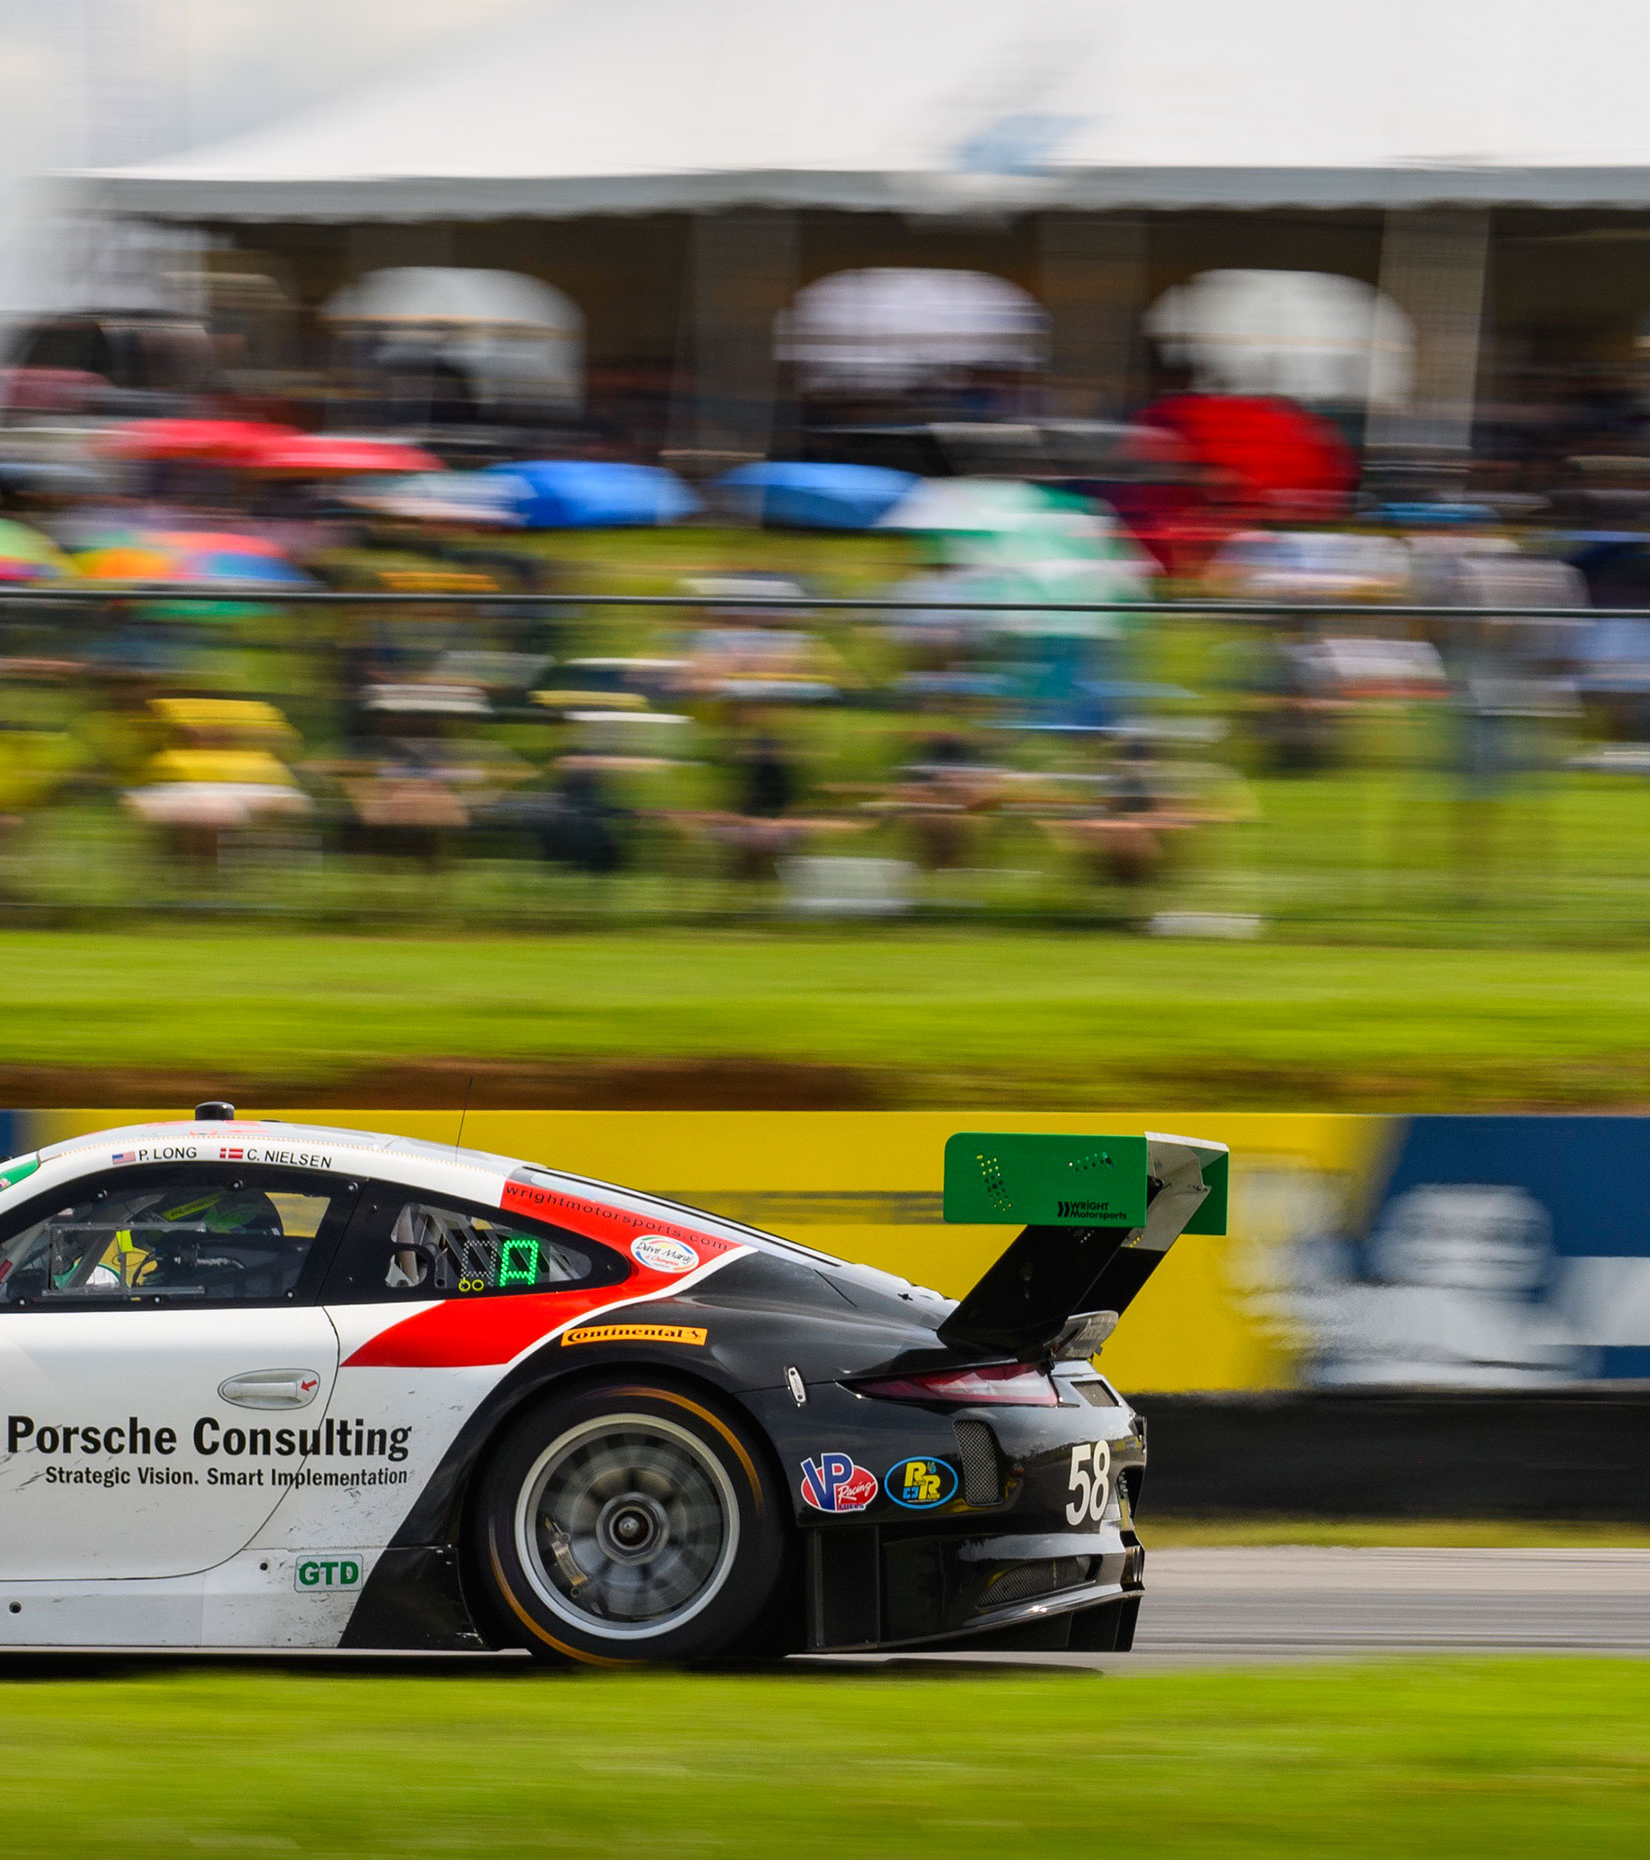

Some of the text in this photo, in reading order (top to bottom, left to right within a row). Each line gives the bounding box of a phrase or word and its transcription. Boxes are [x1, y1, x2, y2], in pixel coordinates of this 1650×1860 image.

[138, 1147, 197, 1160] P. LONG
[246, 1150, 332, 1169] C. NIELSEN
[505, 1184, 728, 1251] wrightmotorsports.com
[1070, 1210, 1127, 1220] Motorsports
[567, 1327, 683, 1342] Continental
[7, 1415, 413, 1462] Porsche Consulting
[45, 1466, 408, 1489] Strategic Vision. Smart Implementation
[801, 1452, 854, 1512] VP
[1065, 1439, 1110, 1526] 58
[837, 1480, 876, 1503] Racing
[298, 1560, 359, 1586] GTD
